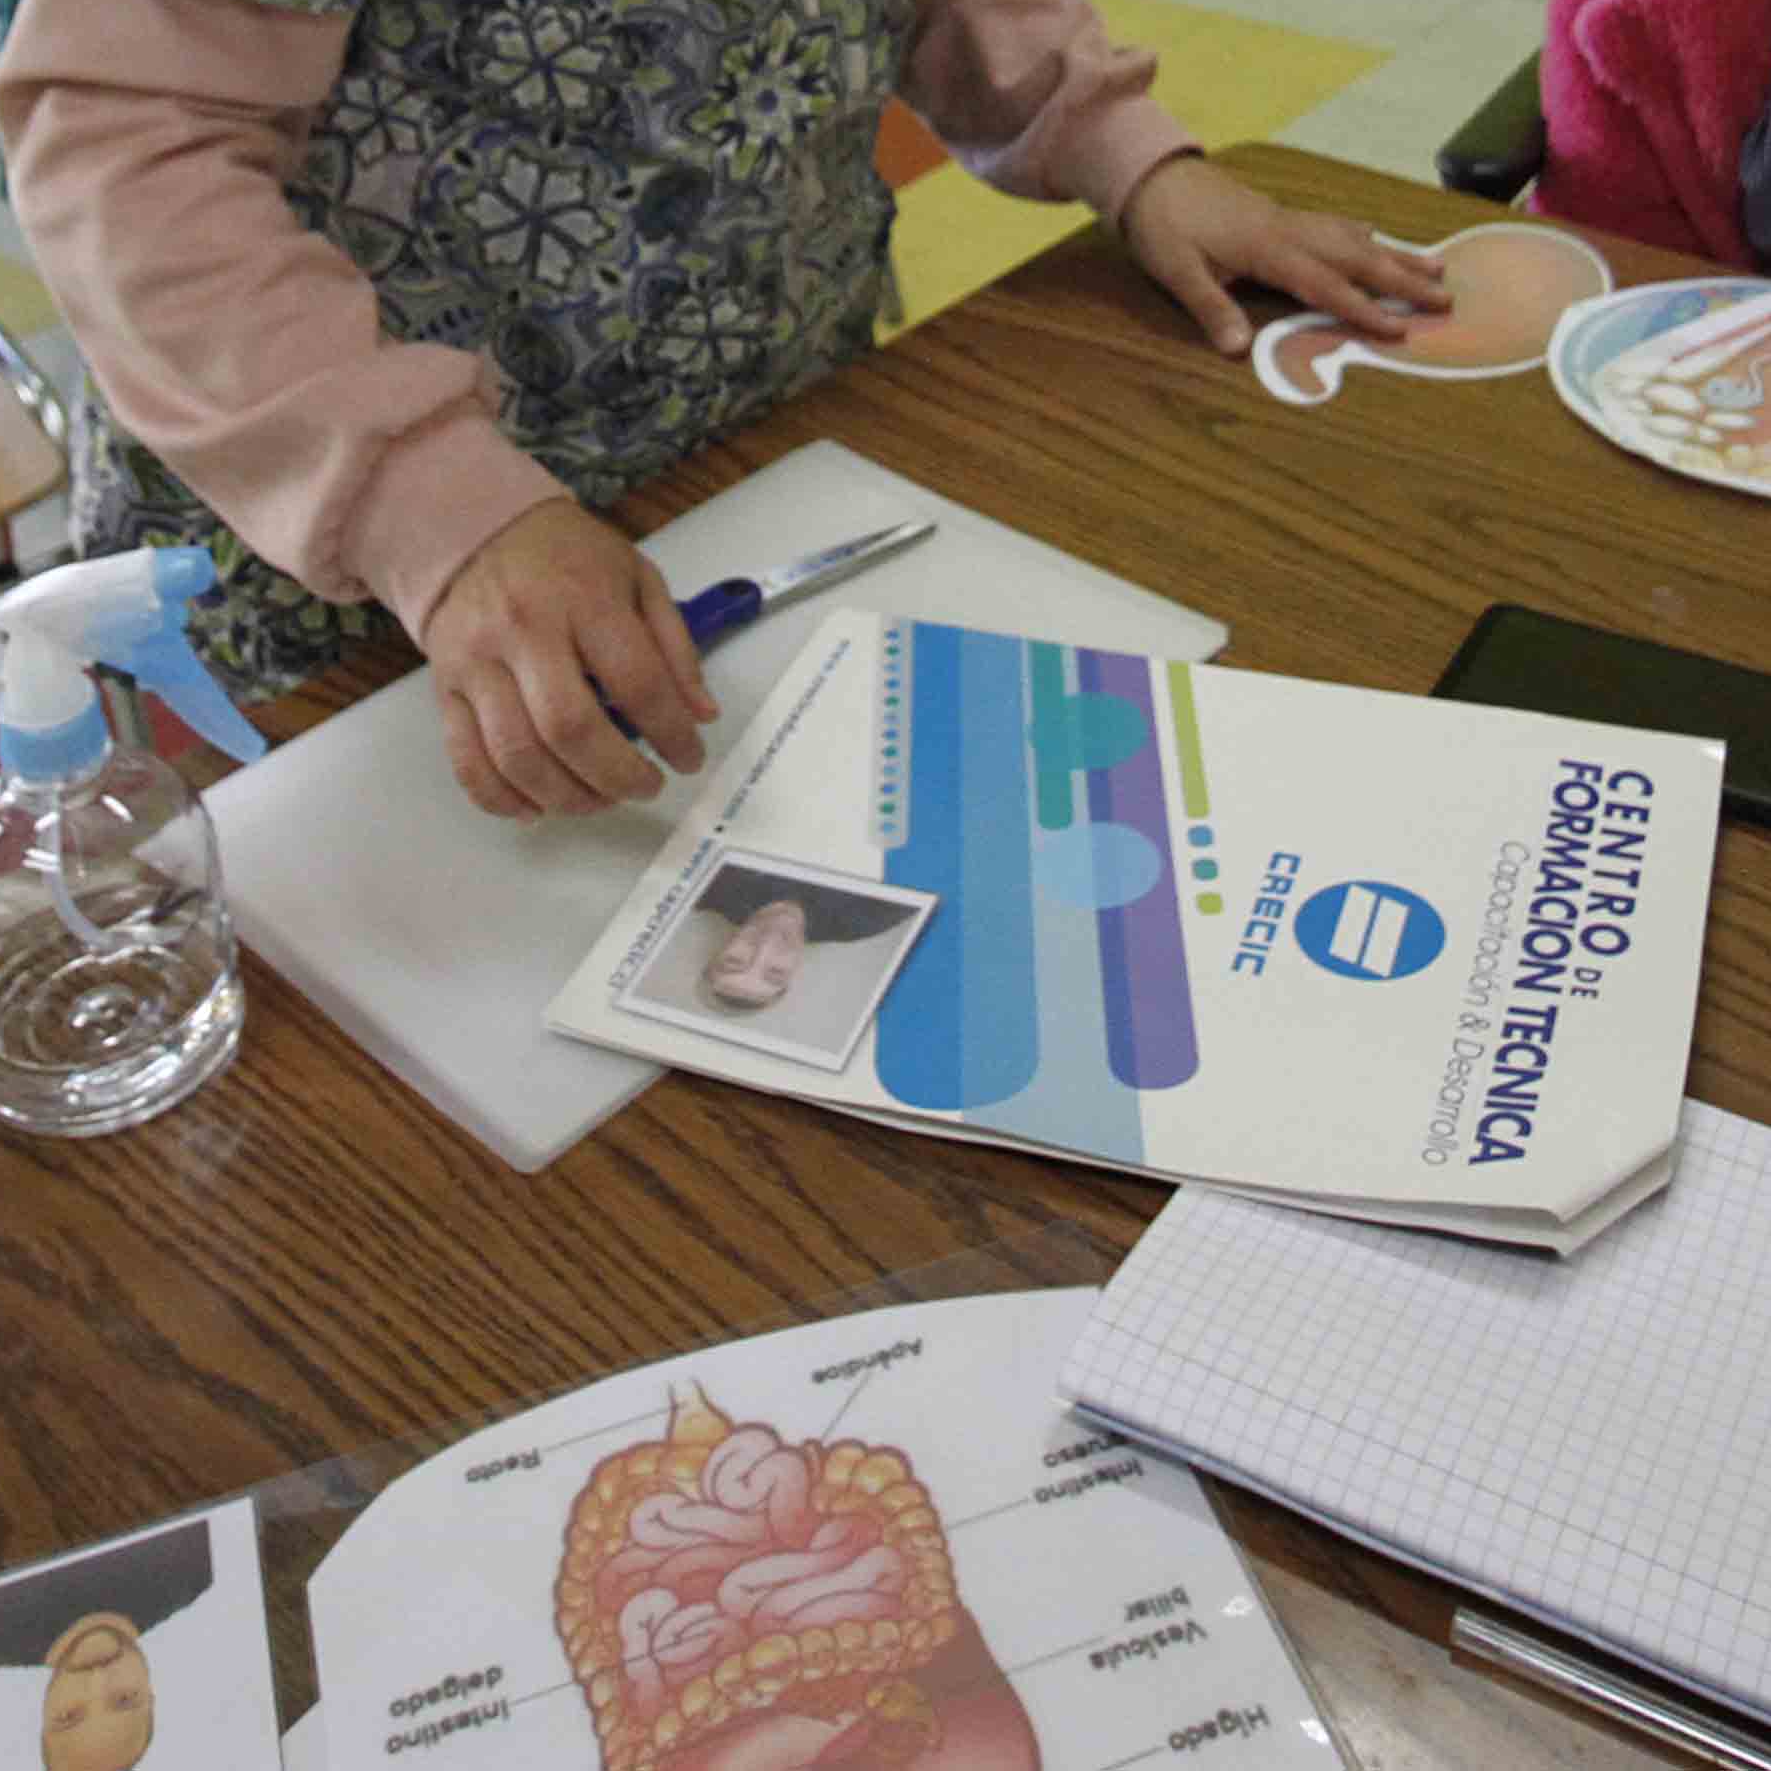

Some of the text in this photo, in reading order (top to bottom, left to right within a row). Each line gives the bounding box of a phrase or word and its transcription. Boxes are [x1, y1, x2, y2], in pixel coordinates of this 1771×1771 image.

[1569, 769, 1655, 1000] CENTRO DE
[1232, 850, 1302, 976] CRECIC
[1467, 758, 1604, 1166] FORMACION TECNICA
[1421, 839, 1531, 1167] Capacitación & Desarrollo
[810, 1336, 924, 1385] Apéndice
[1033, 1457, 1145, 1503] Intestino
[1123, 1584, 1191, 1623] biliar
[1088, 1619, 1209, 1670] Vesícula
[389, 1664, 504, 1717] delgado
[384, 1699, 510, 1754] Intestino
[1168, 1702, 1271, 1752] Hígado
